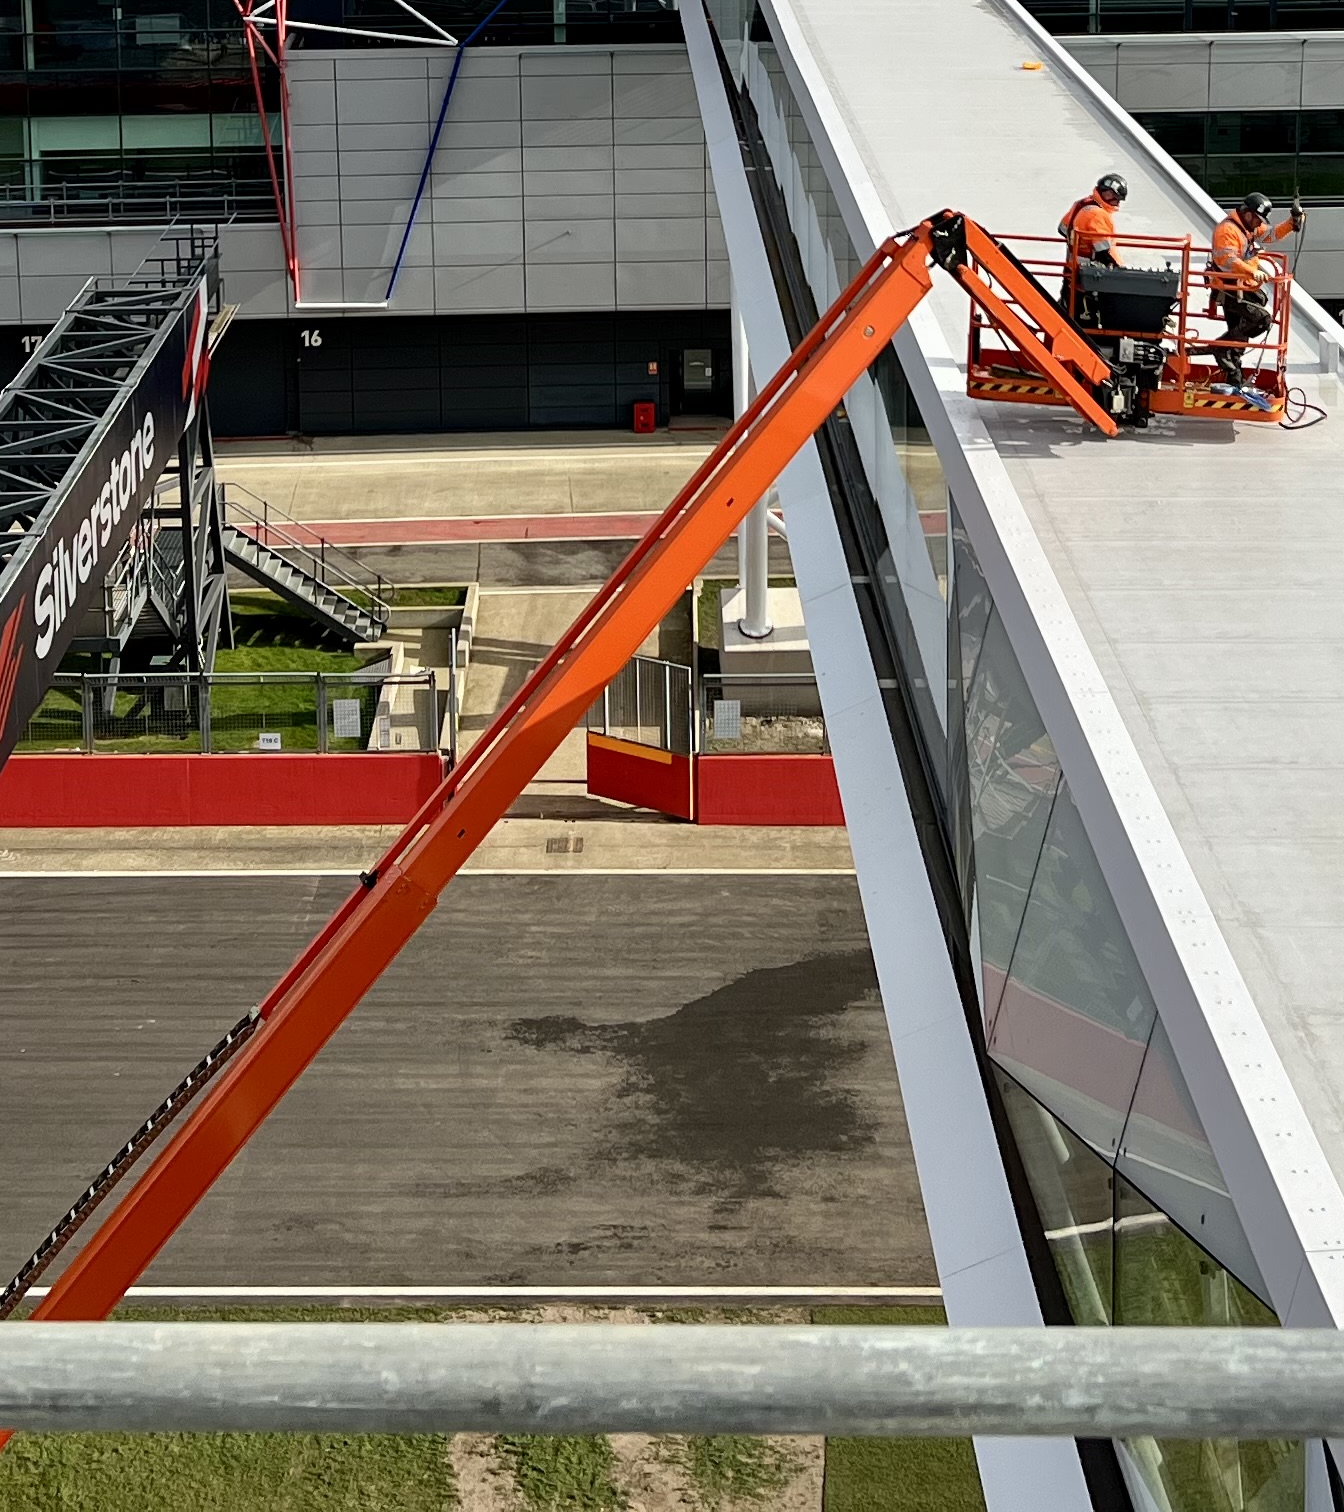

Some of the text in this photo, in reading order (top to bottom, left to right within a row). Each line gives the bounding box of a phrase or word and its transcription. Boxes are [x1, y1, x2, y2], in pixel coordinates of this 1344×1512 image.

[21, 335, 43, 353] 17
[300, 330, 322, 346] 16
[34, 411, 155, 660] Silverstone
